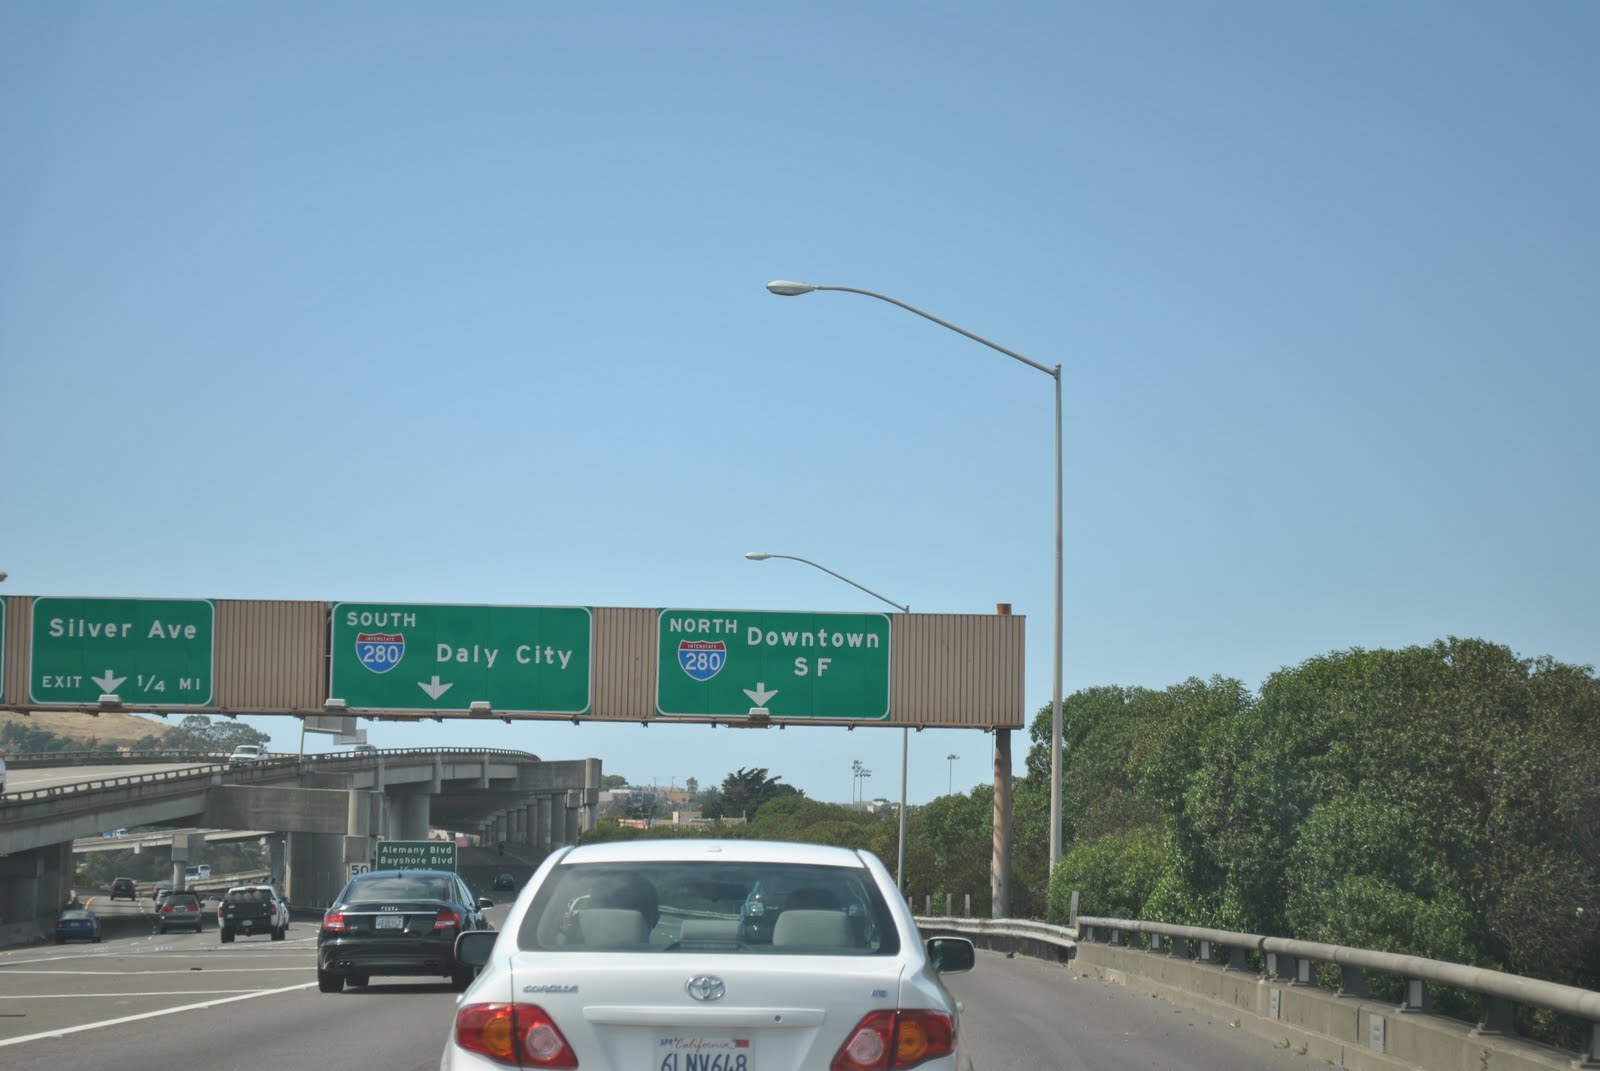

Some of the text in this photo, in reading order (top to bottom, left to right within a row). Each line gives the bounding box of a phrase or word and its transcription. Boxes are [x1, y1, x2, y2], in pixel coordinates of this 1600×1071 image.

[346, 611, 416, 627] SOUTH
[670, 617, 737, 634] NORTH
[48, 618, 197, 639] Silver Ave
[747, 626, 879, 648] Downtown
[362, 644, 399, 663] 280
[436, 643, 573, 670] Daly City
[685, 652, 721, 671] 280
[41, 674, 201, 692] EXIT 1/4 MI
[382, 846, 452, 856] Alemany Blvd
[351, 864, 369, 875] 50
[380, 856, 453, 867] Bayshore Blvd
[675, 1037, 733, 1052] California
